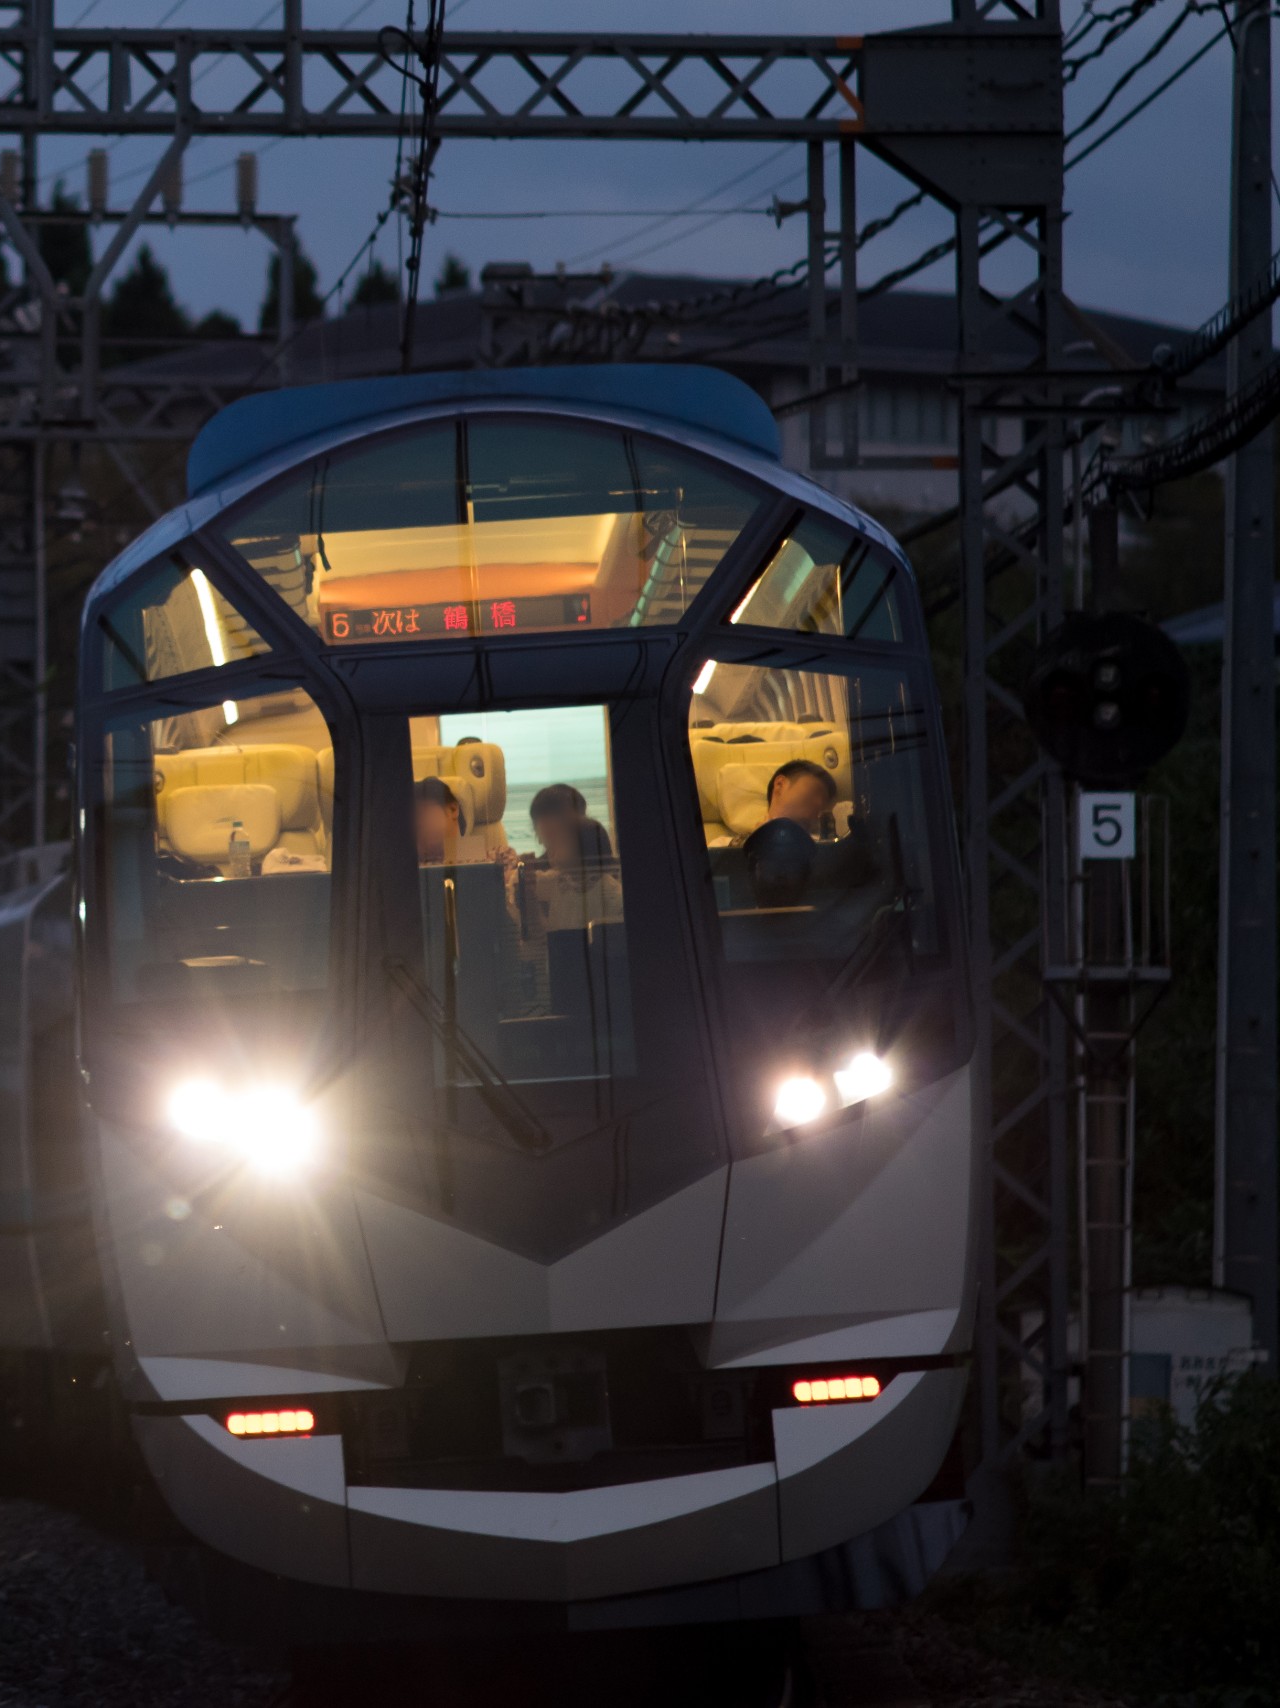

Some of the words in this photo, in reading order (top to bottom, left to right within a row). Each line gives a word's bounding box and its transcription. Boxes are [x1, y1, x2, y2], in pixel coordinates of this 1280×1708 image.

[332, 613, 350, 638] 6
[372, 609, 421, 635] 次は
[1092, 804, 1122, 846] 5
